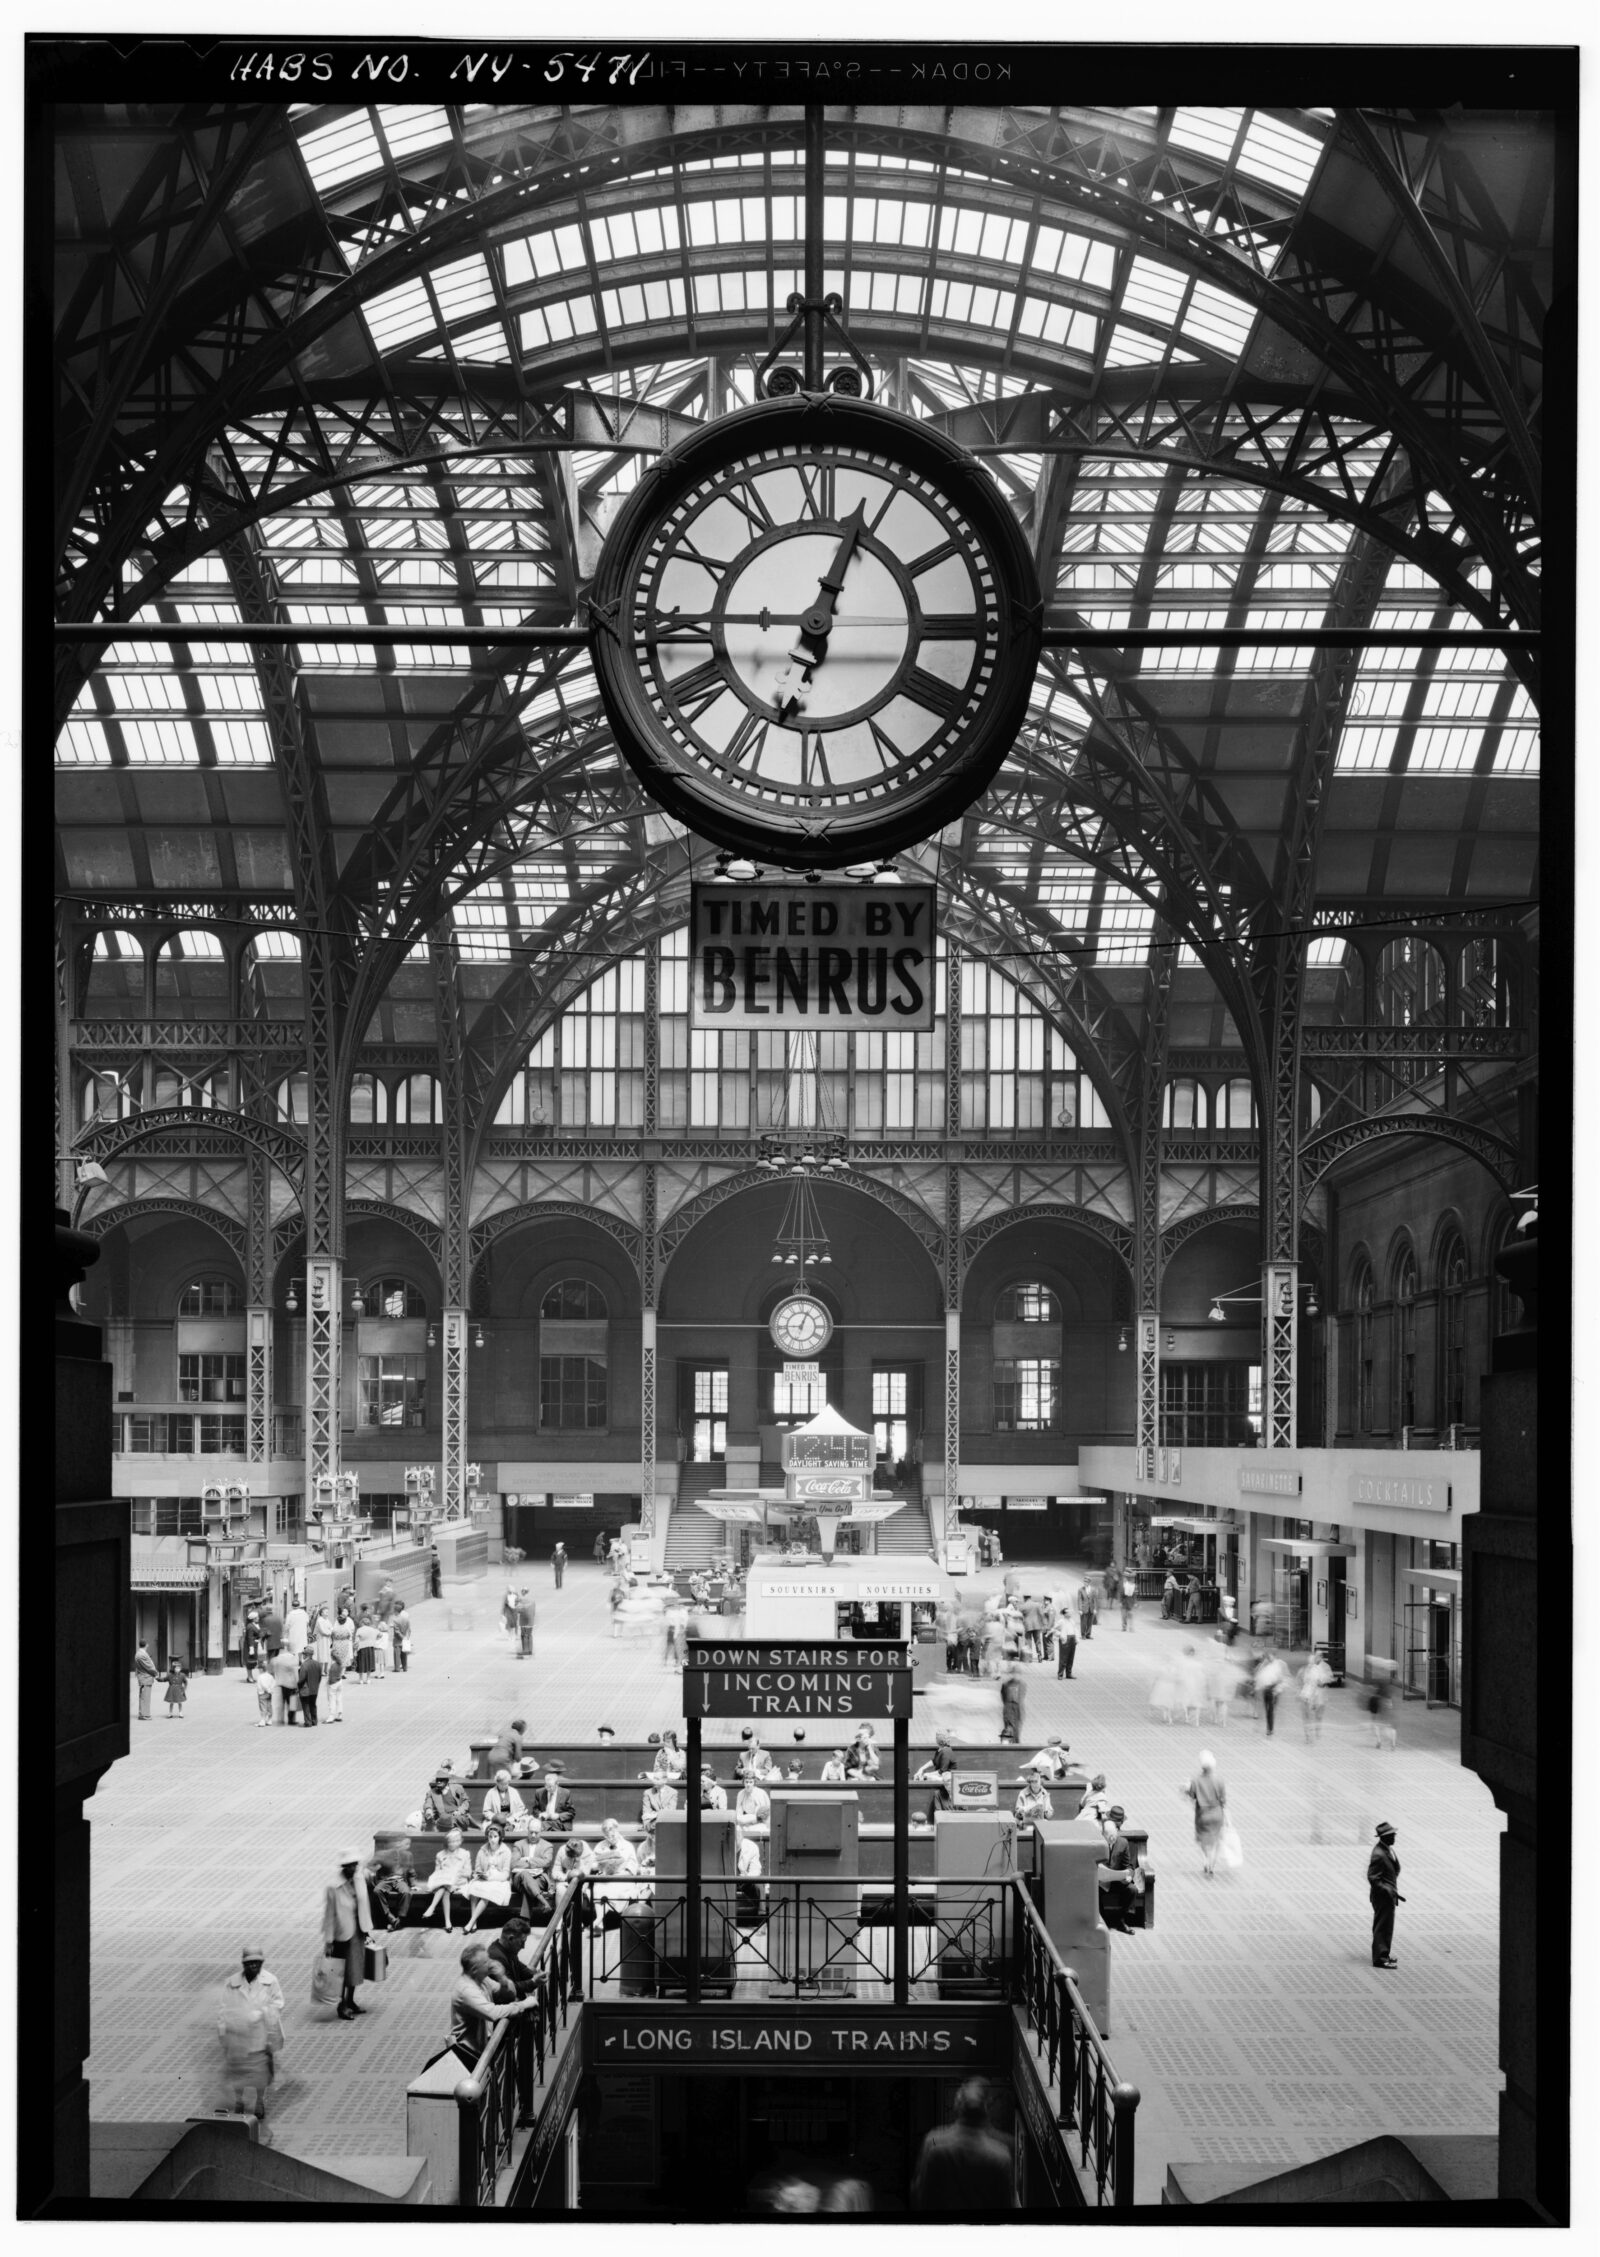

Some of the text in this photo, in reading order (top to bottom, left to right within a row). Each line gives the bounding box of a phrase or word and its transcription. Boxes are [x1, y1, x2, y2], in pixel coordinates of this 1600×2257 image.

[703, 901, 924, 937] TIMED BY
[703, 946, 925, 1015] BENRUS
[784, 1371, 818, 1382] BENRUS
[790, 1436, 868, 1461] 12:45
[789, 1460, 868, 1468] DAYLIGHT SAVING TIME
[805, 1479, 853, 1495] Coca-Cola
[1358, 1479, 1433, 1506] COCKTAILS
[769, 1586, 836, 1595] SOUVENIRS
[866, 1586, 932, 1595] NOVELTIES
[696, 1650, 900, 1665] DOWN STAIRS FOR
[724, 1673, 873, 1691] INCOMING
[747, 1695, 853, 1713] TRAINS
[622, 2029, 951, 2051] LONG ISLAND TRAINS
